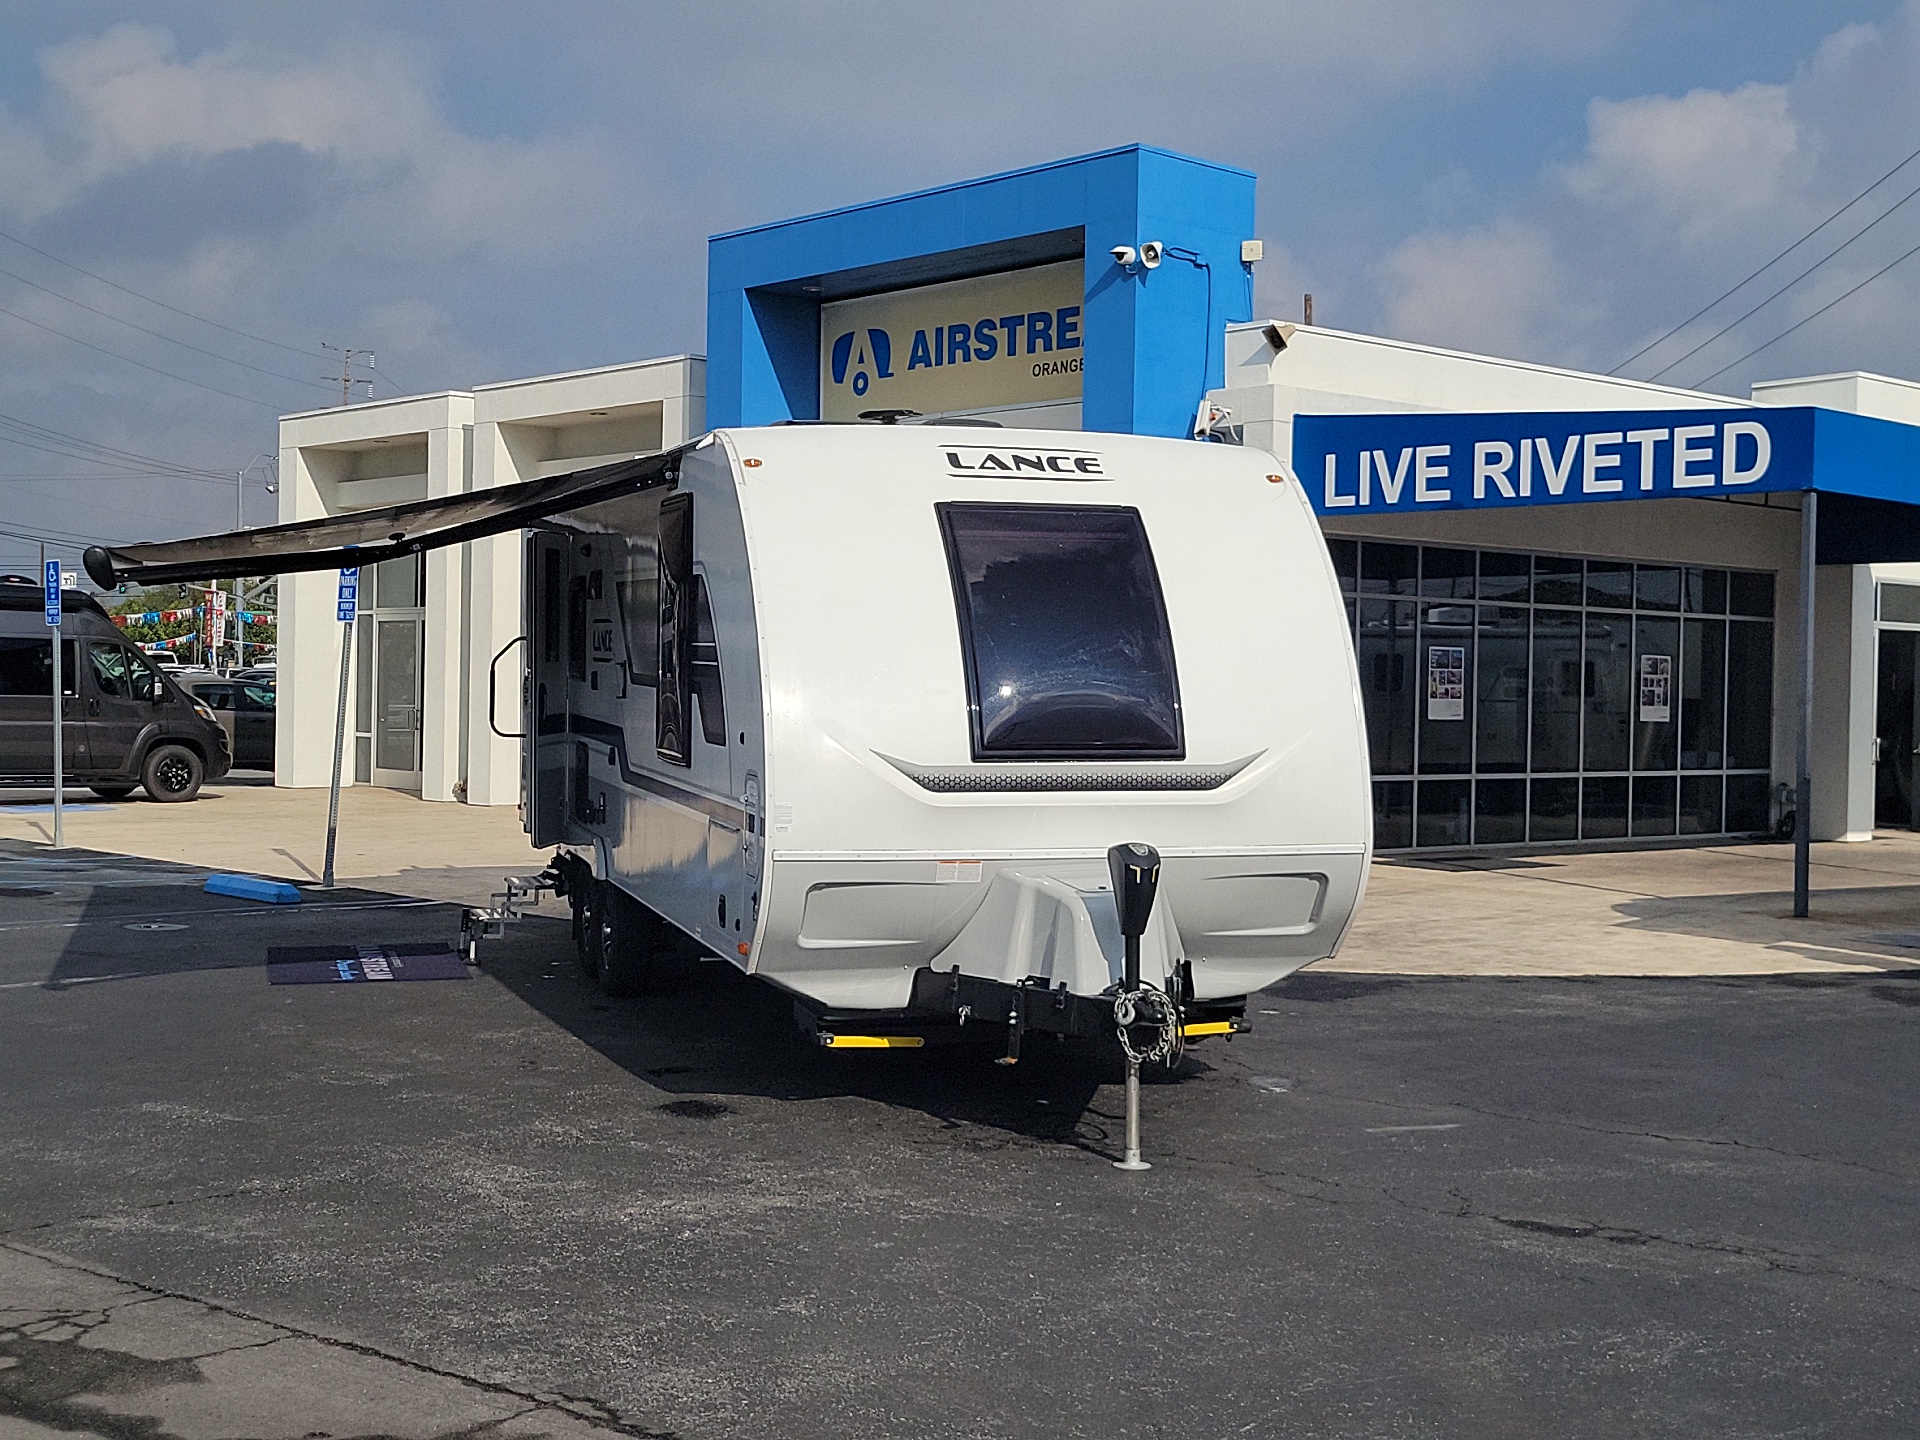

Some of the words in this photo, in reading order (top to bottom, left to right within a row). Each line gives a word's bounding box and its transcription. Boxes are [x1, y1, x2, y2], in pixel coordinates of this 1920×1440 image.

[907, 305, 1084, 371] AIRSTRE
[945, 452, 1104, 475] LANCE
[1324, 444, 1452, 508] LIVE
[1473, 420, 1772, 499] RIVETED
